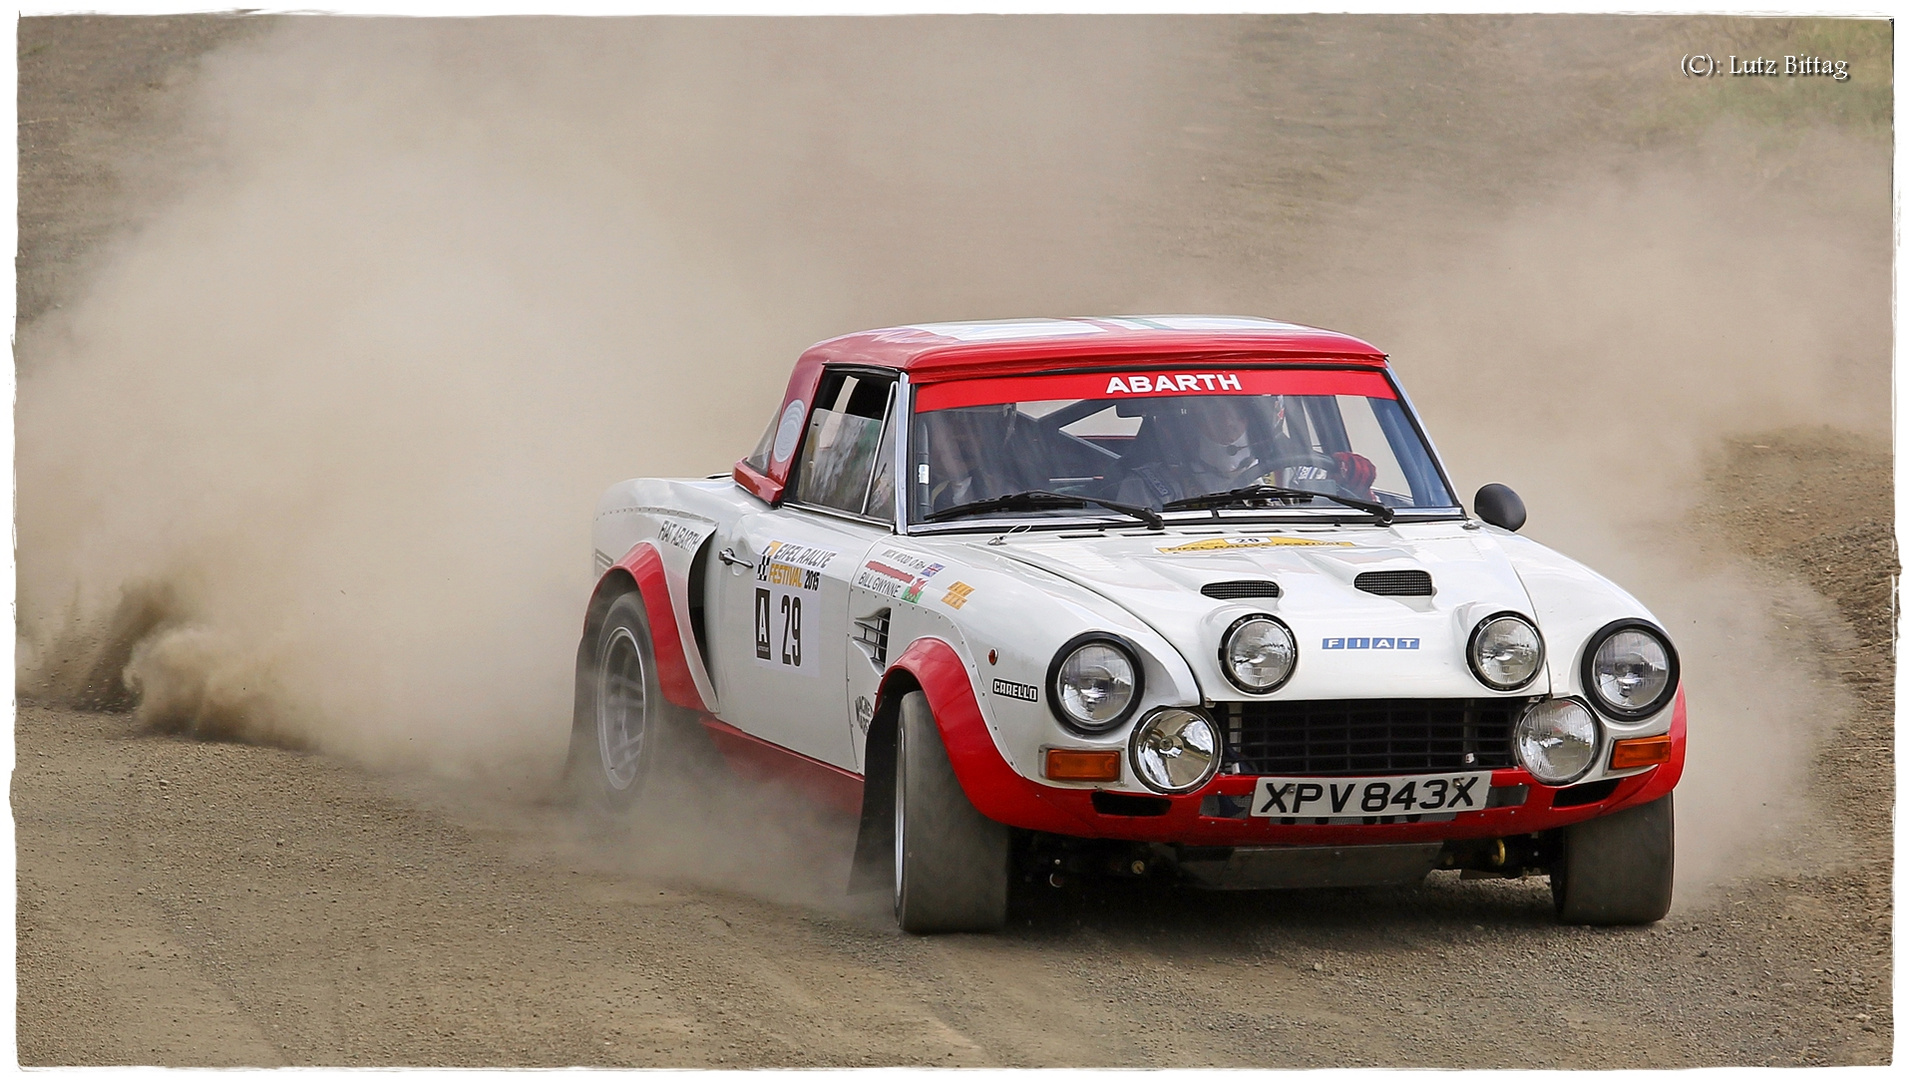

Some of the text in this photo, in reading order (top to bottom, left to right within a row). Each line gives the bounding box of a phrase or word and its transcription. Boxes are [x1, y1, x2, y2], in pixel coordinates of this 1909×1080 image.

[1105, 374, 1243, 394] ABARTH
[658, 520, 702, 552] FIAT ABARTH
[774, 543, 837, 568] EIFEL RALLYE
[768, 563, 820, 591] FESTIVAL 2015
[859, 572, 901, 597] BILL GWYNNE
[759, 594, 801, 667] A 29
[1324, 638, 1418, 649] FIAT
[993, 680, 1037, 700] CARELLO
